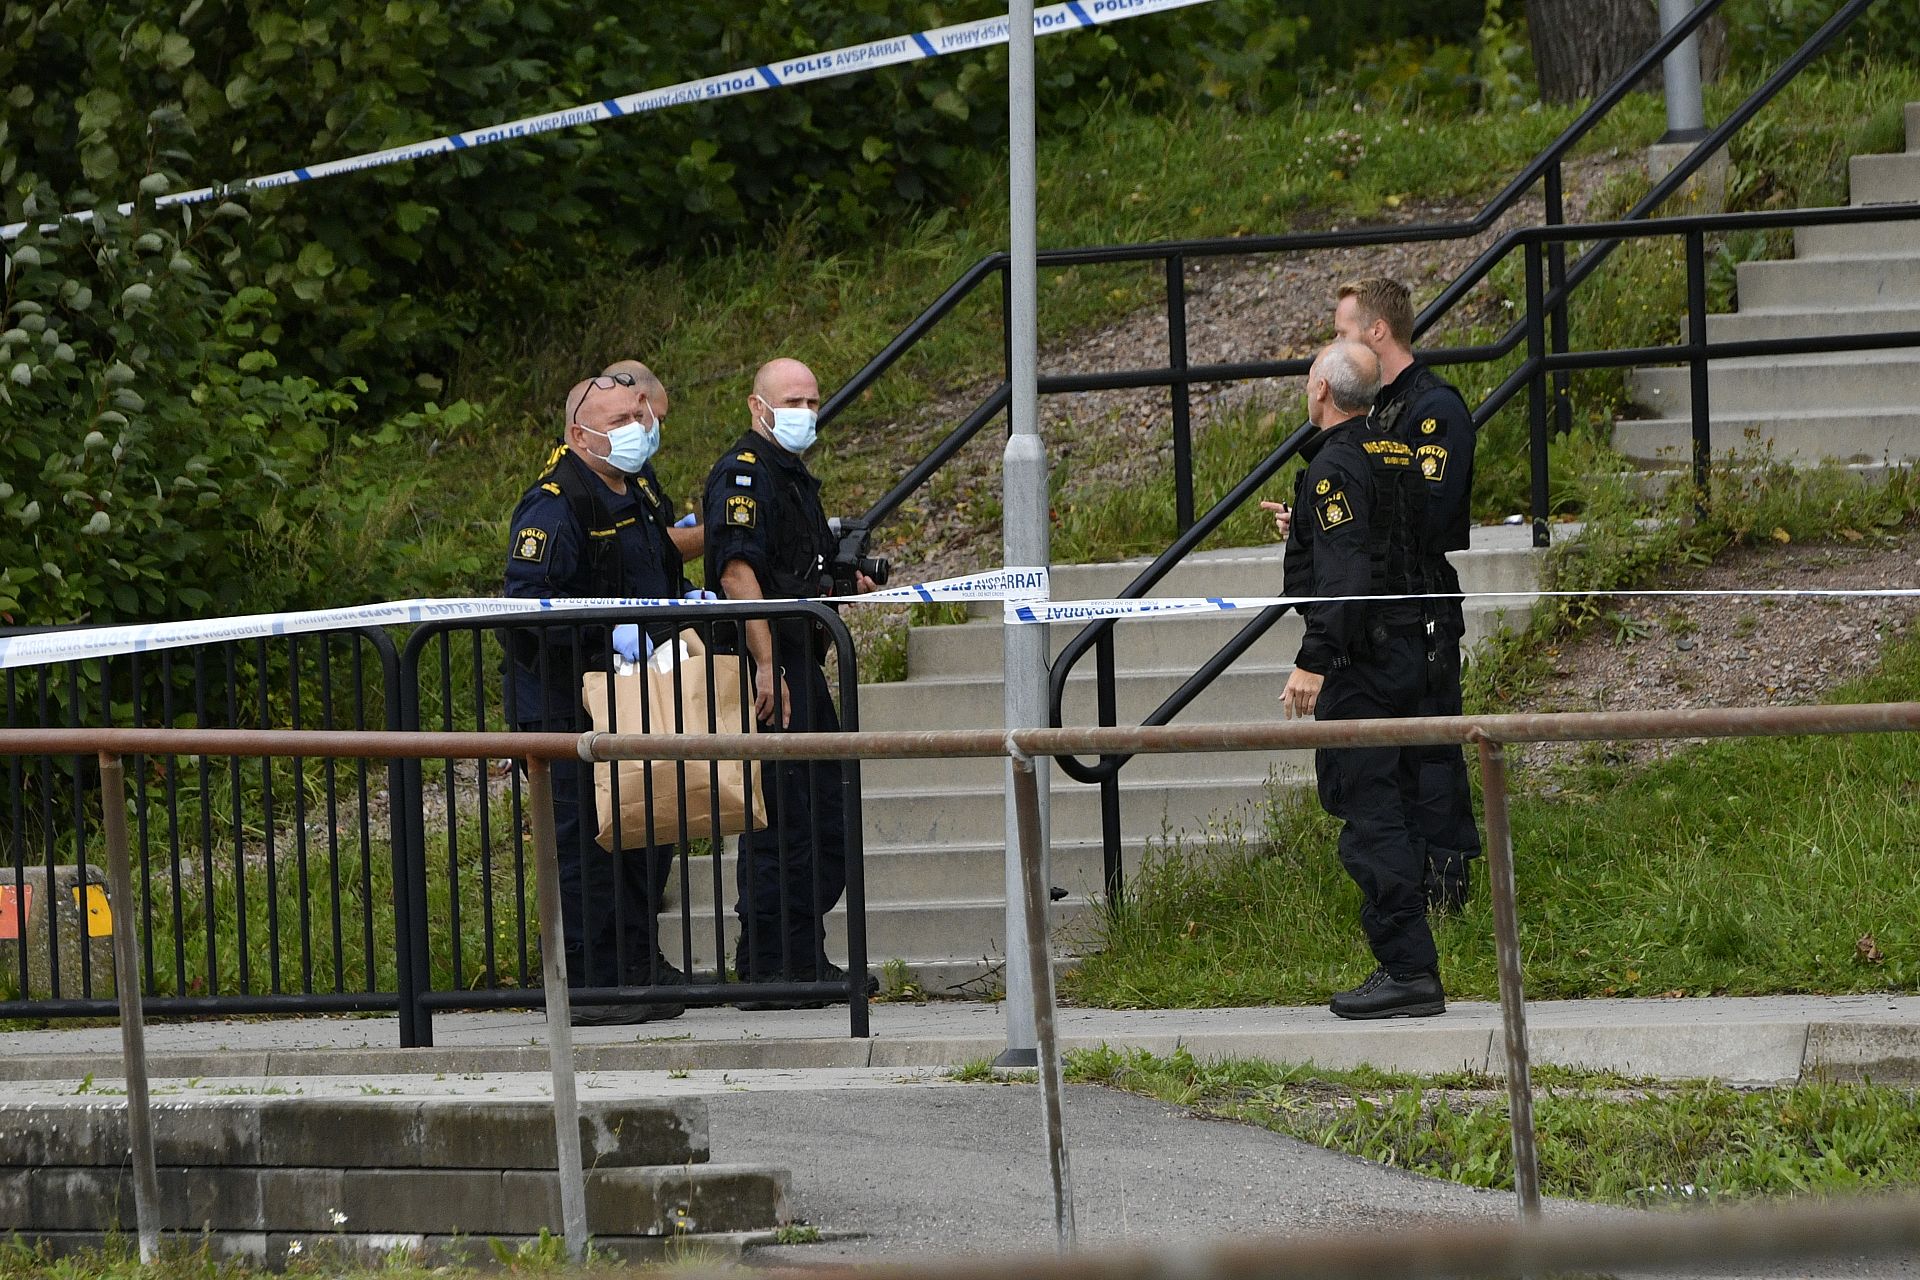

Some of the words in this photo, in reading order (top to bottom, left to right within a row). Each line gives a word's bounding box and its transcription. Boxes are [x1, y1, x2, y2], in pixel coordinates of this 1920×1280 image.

[1034, 11, 1066, 29] POL
[782, 55, 833, 77] POLIS
[836, 39, 907, 66] AVSPÄRRAT
[706, 75, 755, 96] POLIS
[475, 125, 525, 145] POLIS
[1420, 446, 1445, 458] POLIS
[729, 497, 754, 508] POLIS
[521, 529, 545, 541] POLIS
